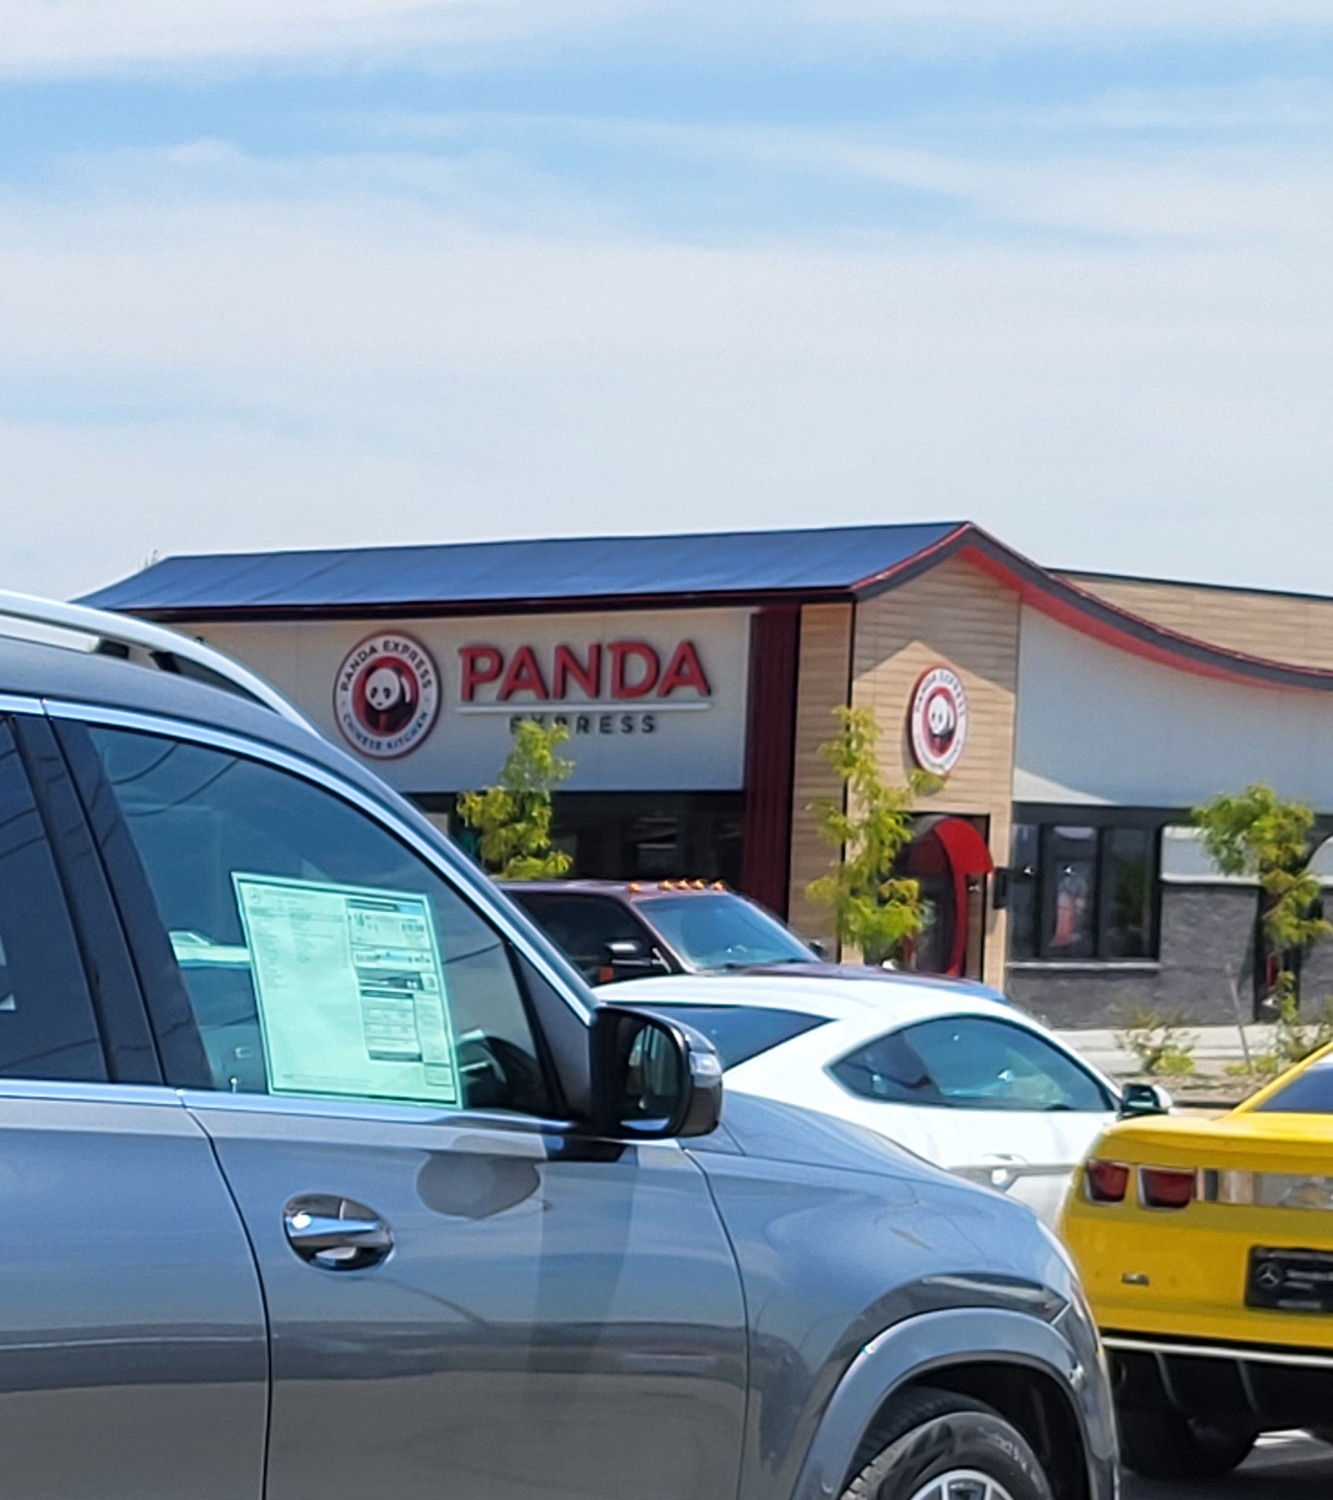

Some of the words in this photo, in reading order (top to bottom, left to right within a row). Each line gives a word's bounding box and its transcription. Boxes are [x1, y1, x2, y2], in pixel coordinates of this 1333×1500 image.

[339, 645, 378, 692] PANDA
[383, 640, 432, 689] EXPRESS
[458, 640, 712, 702] PANDA
